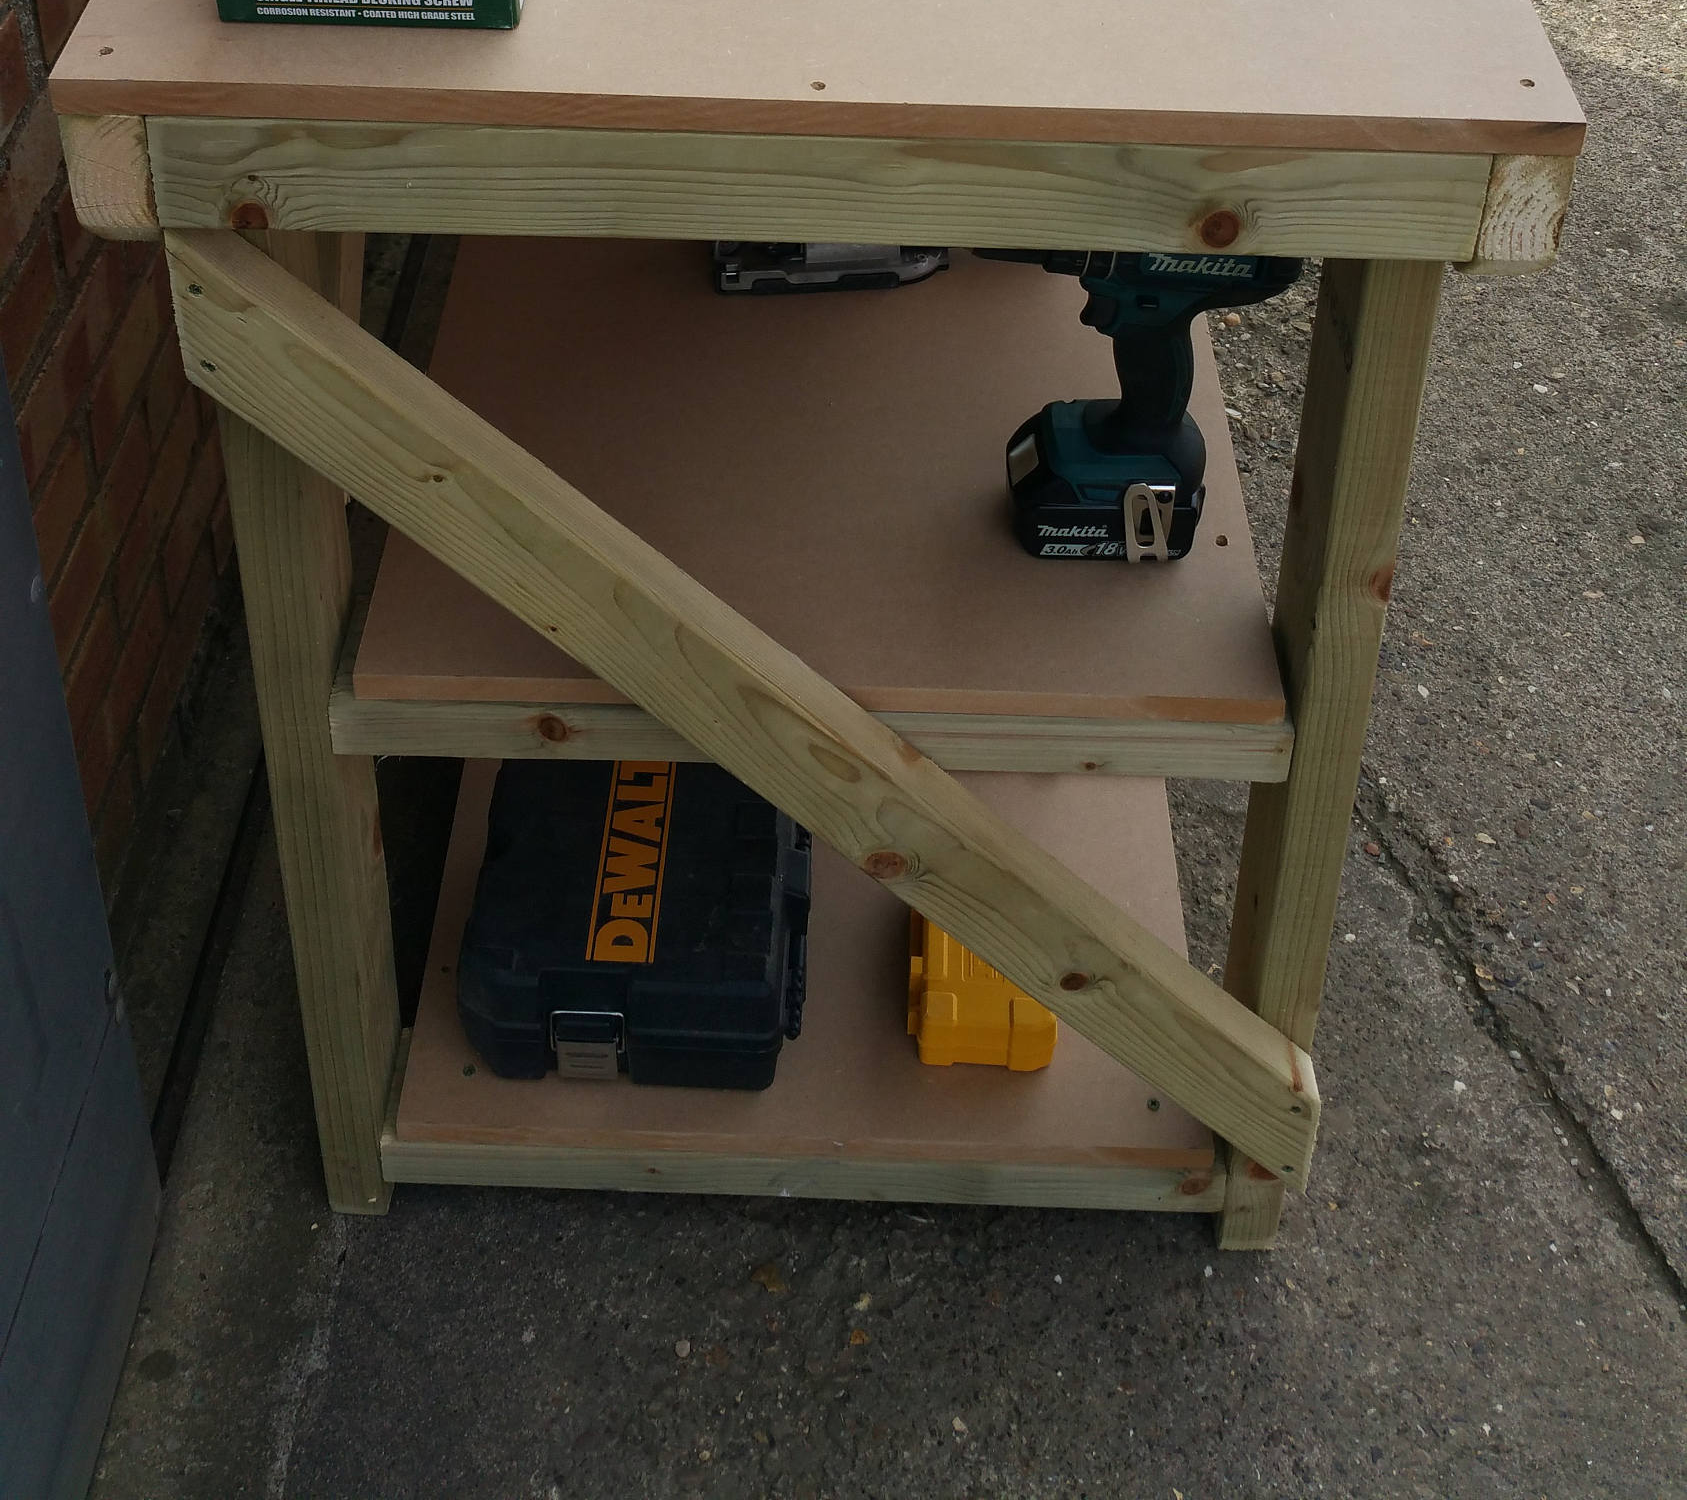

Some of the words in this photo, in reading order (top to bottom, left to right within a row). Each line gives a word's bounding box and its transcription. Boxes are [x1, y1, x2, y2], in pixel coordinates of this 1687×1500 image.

[257, 7, 308, 17] CORROSION
[309, 8, 356, 18] RESISTANT
[363, 10, 397, 19] COATED
[398, 11, 420, 20] HIGH
[421, 11, 450, 20] GRADE
[450, 12, 476, 21] STEEL
[593, 760, 670, 963] DEWALT
